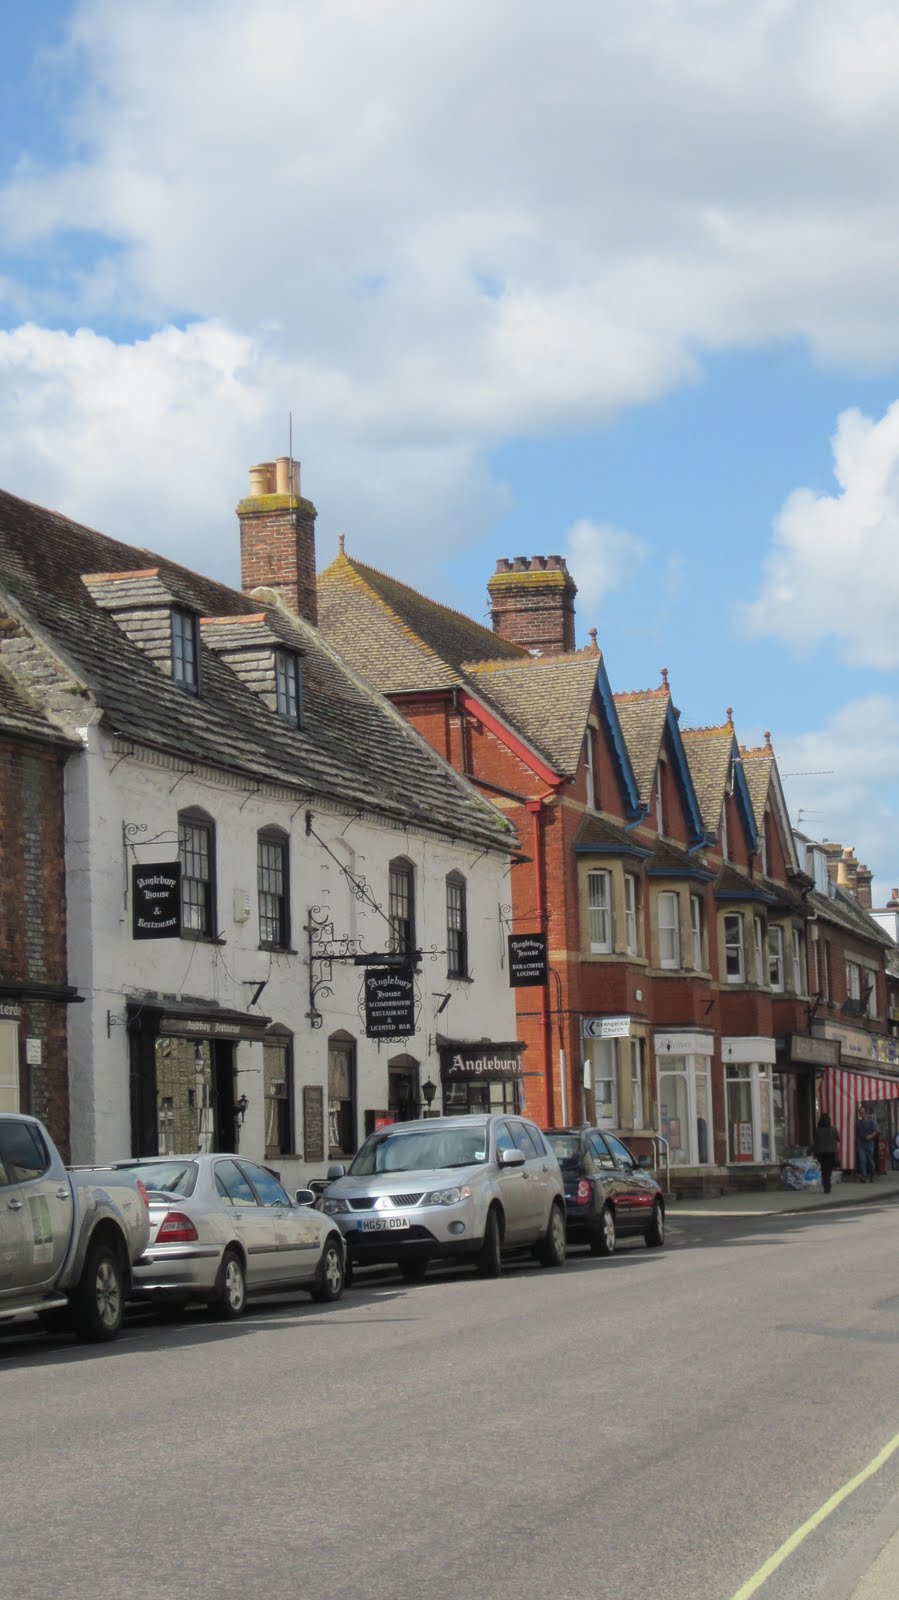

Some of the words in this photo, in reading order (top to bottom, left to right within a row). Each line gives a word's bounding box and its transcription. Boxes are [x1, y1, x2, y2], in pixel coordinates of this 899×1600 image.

[136, 875, 177, 888] Anglebury
[143, 890, 170, 900] House
[153, 906, 162, 915] &
[136, 917, 177, 929] Restaurant
[512, 940, 544, 950] Anglebury
[516, 950, 538, 958] House
[367, 975, 412, 990] Anglebury
[376, 990, 402, 1000] House
[658, 1039, 691, 1049] Slicitors
[448, 1054, 517, 1074] Anglebury
[363, 1220, 387, 1230] HG57
[389, 1218, 408, 1228] ODA
